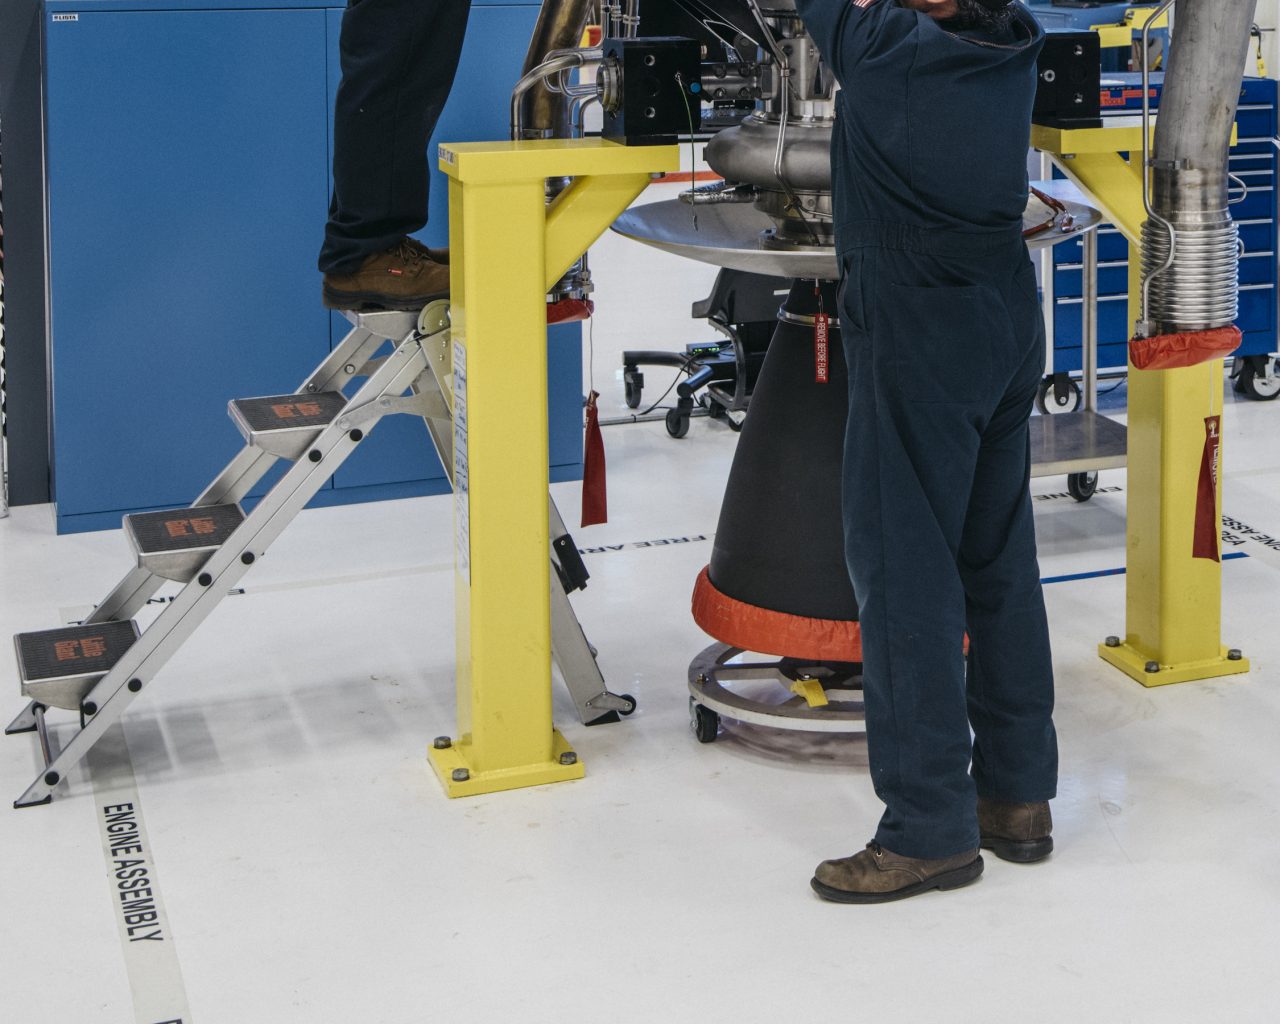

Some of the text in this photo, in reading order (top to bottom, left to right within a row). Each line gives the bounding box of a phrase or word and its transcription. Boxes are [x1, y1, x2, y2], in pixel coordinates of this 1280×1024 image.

[817, 322, 827, 381] REMOVE BEFORE FLIGHT
[633, 535, 707, 548] FREE
[103, 802, 164, 943] ENGINE ASSEMBLY
